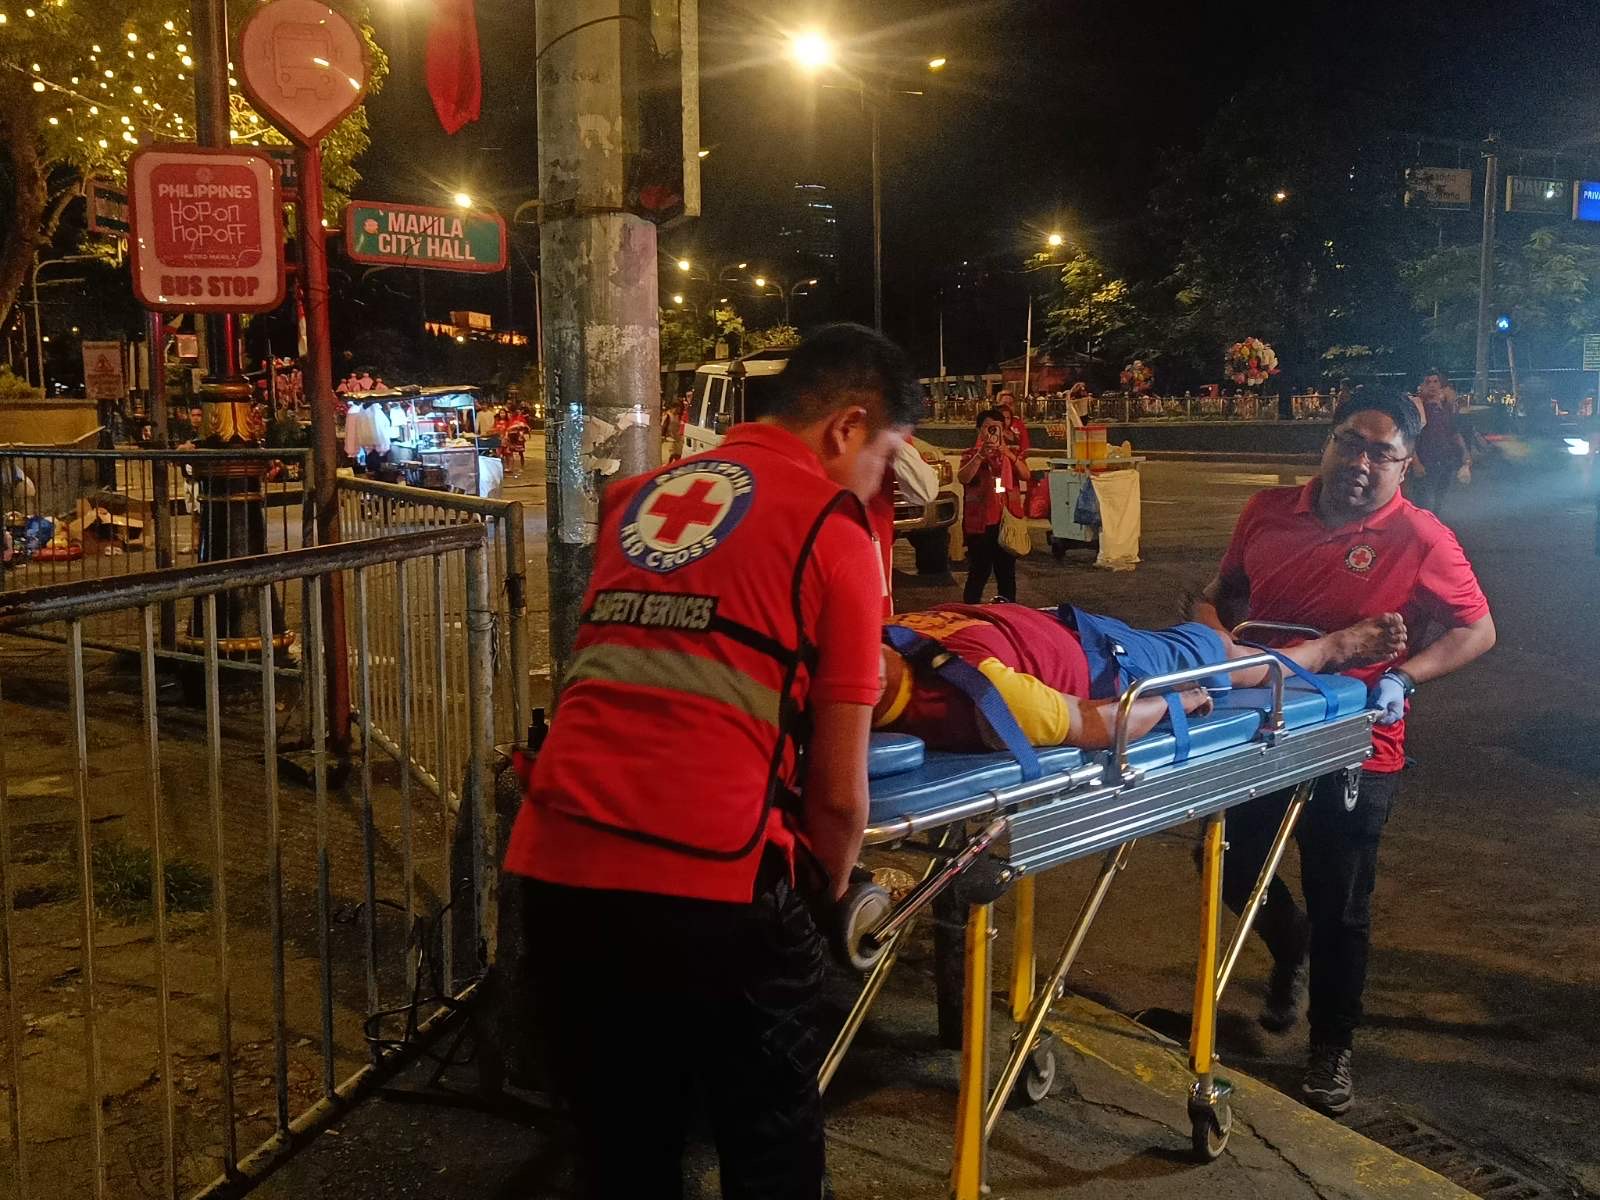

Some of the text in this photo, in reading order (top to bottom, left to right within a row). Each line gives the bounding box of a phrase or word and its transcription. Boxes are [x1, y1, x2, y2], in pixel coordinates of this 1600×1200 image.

[158, 184, 252, 198] PHILIPPINES
[388, 212, 464, 238] MANILA
[378, 233, 475, 260] CITY HALL
[161, 275, 259, 297] BUS STOP
[646, 536, 717, 569] CROSS
